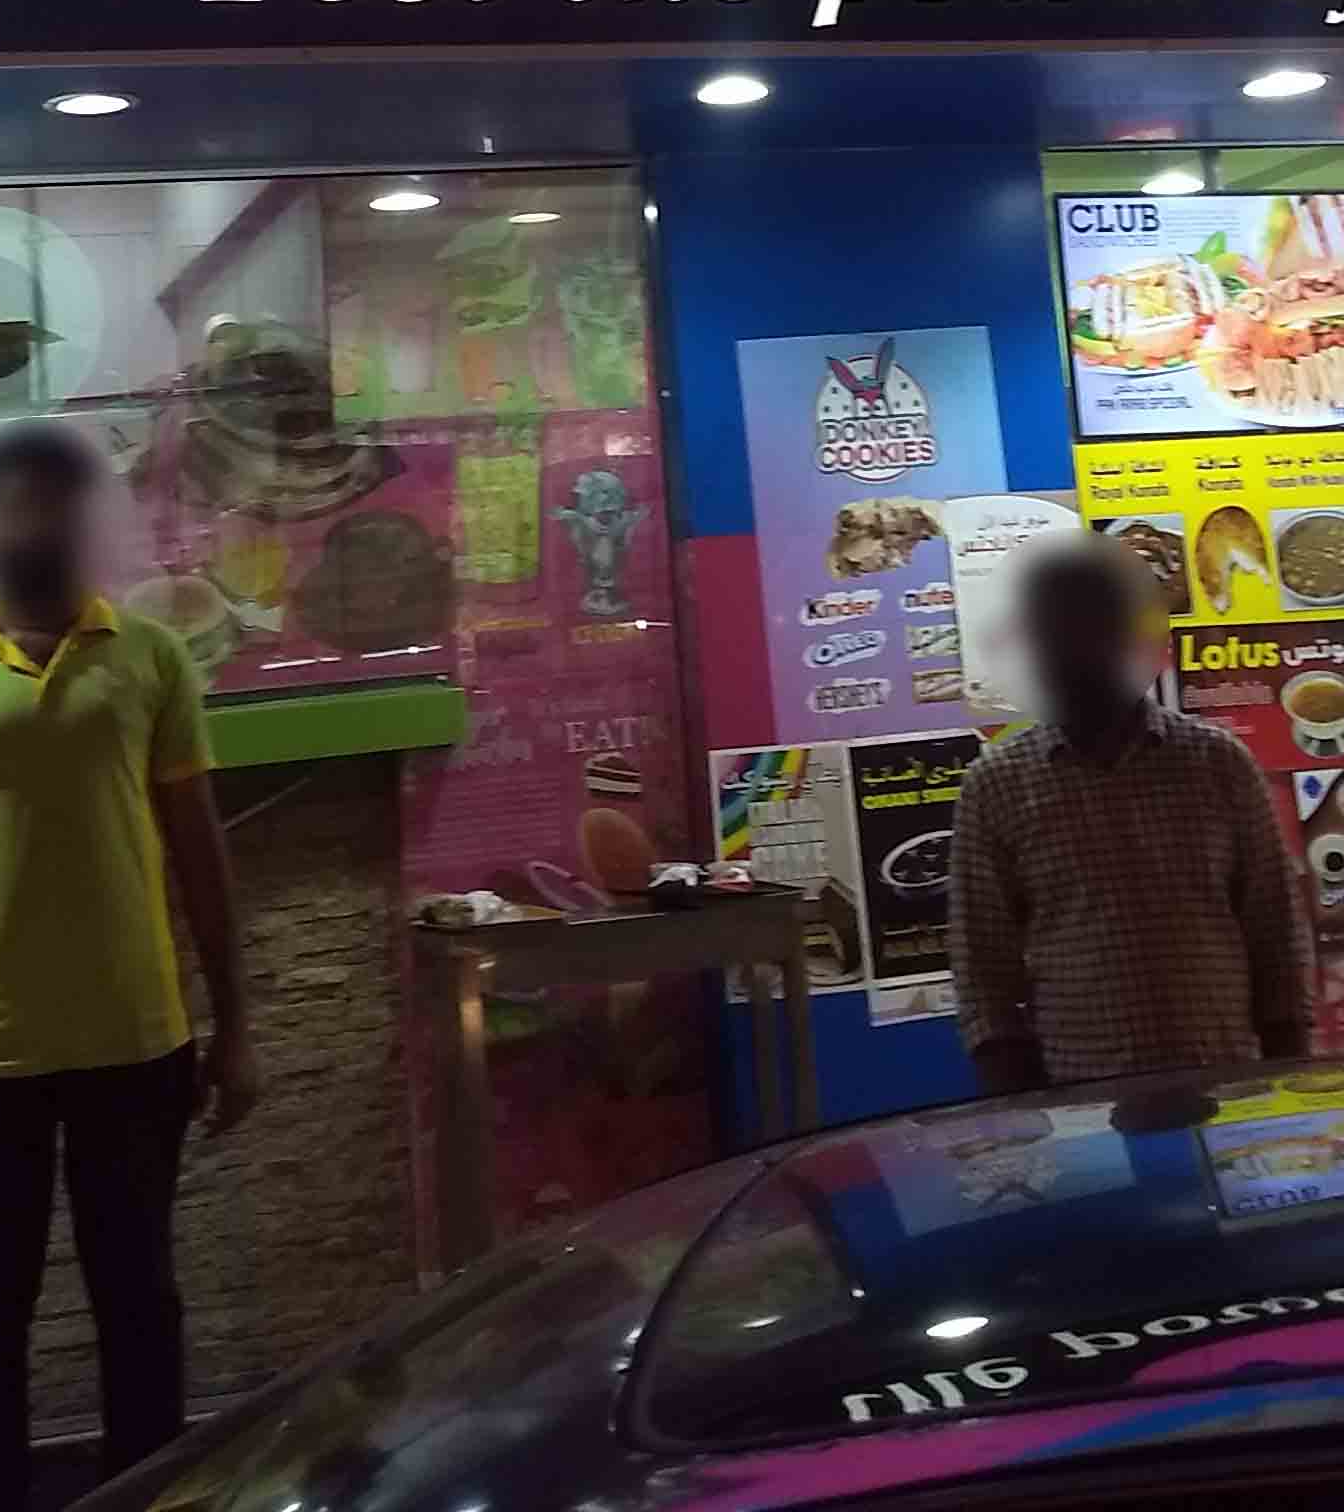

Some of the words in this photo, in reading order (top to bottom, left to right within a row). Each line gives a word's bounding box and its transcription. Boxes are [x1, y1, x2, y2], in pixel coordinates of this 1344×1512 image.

[1068, 203, 1161, 233] CLUB
[822, 417, 930, 444] DONKEY
[820, 439, 936, 468] COOKIES
[1179, 634, 1281, 672] Lotus
